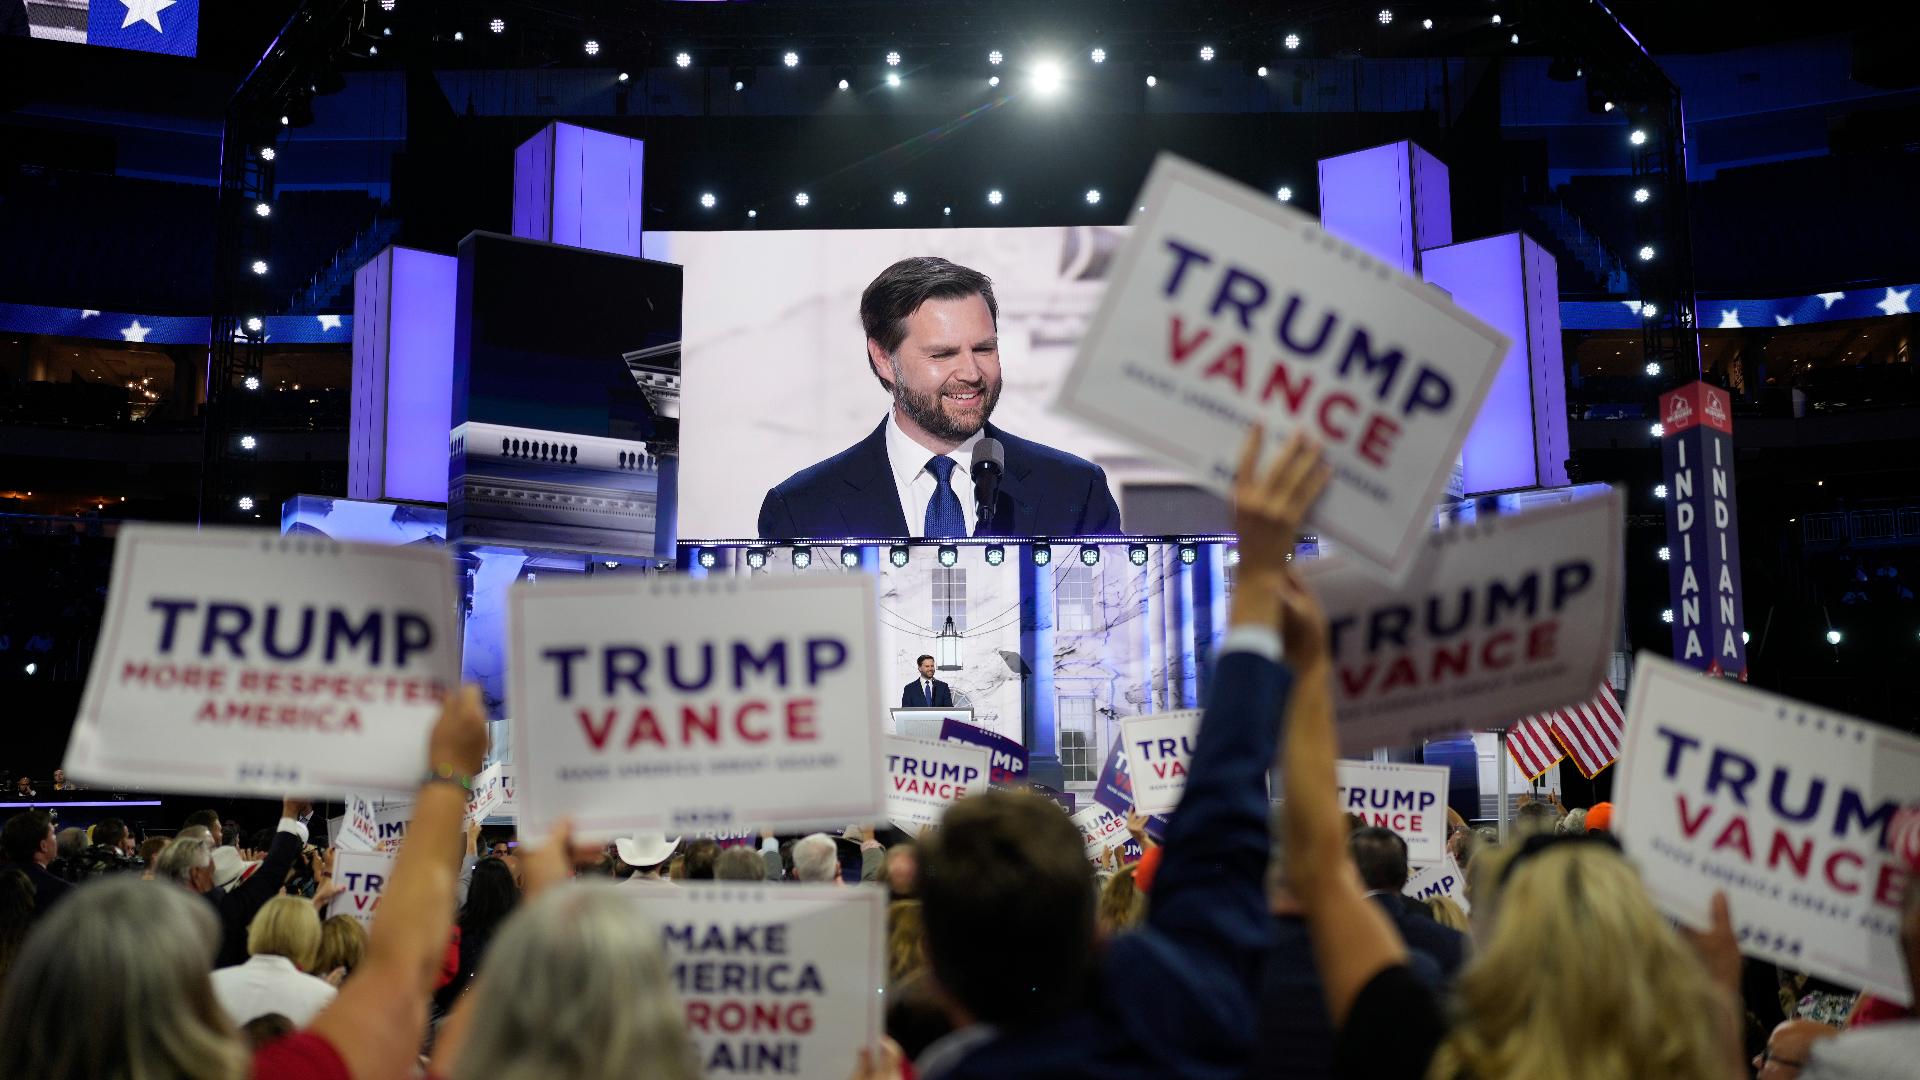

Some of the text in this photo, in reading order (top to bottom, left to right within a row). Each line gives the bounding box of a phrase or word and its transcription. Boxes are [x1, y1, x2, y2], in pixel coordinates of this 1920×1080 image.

[1161, 237, 1455, 418] TRUMP
[1166, 314, 1402, 469] VANCE
[1675, 438, 1703, 660] INDIANA
[1712, 437, 1737, 659] INDIANA
[150, 599, 434, 668] TRUMP
[1339, 620, 1559, 699] VANCE
[122, 661, 227, 690] MORE
[541, 638, 849, 699] TRUMP
[197, 699, 363, 733] AMERICA
[576, 699, 820, 752] VANCE
[886, 754, 978, 784] TRUMP
[1136, 736, 1194, 760] TRU
[1656, 724, 1902, 850] TRUM
[1087, 818, 1123, 843] ANCE
[685, 1001, 815, 1035] RONG
[706, 1041, 800, 1074] AIN!
